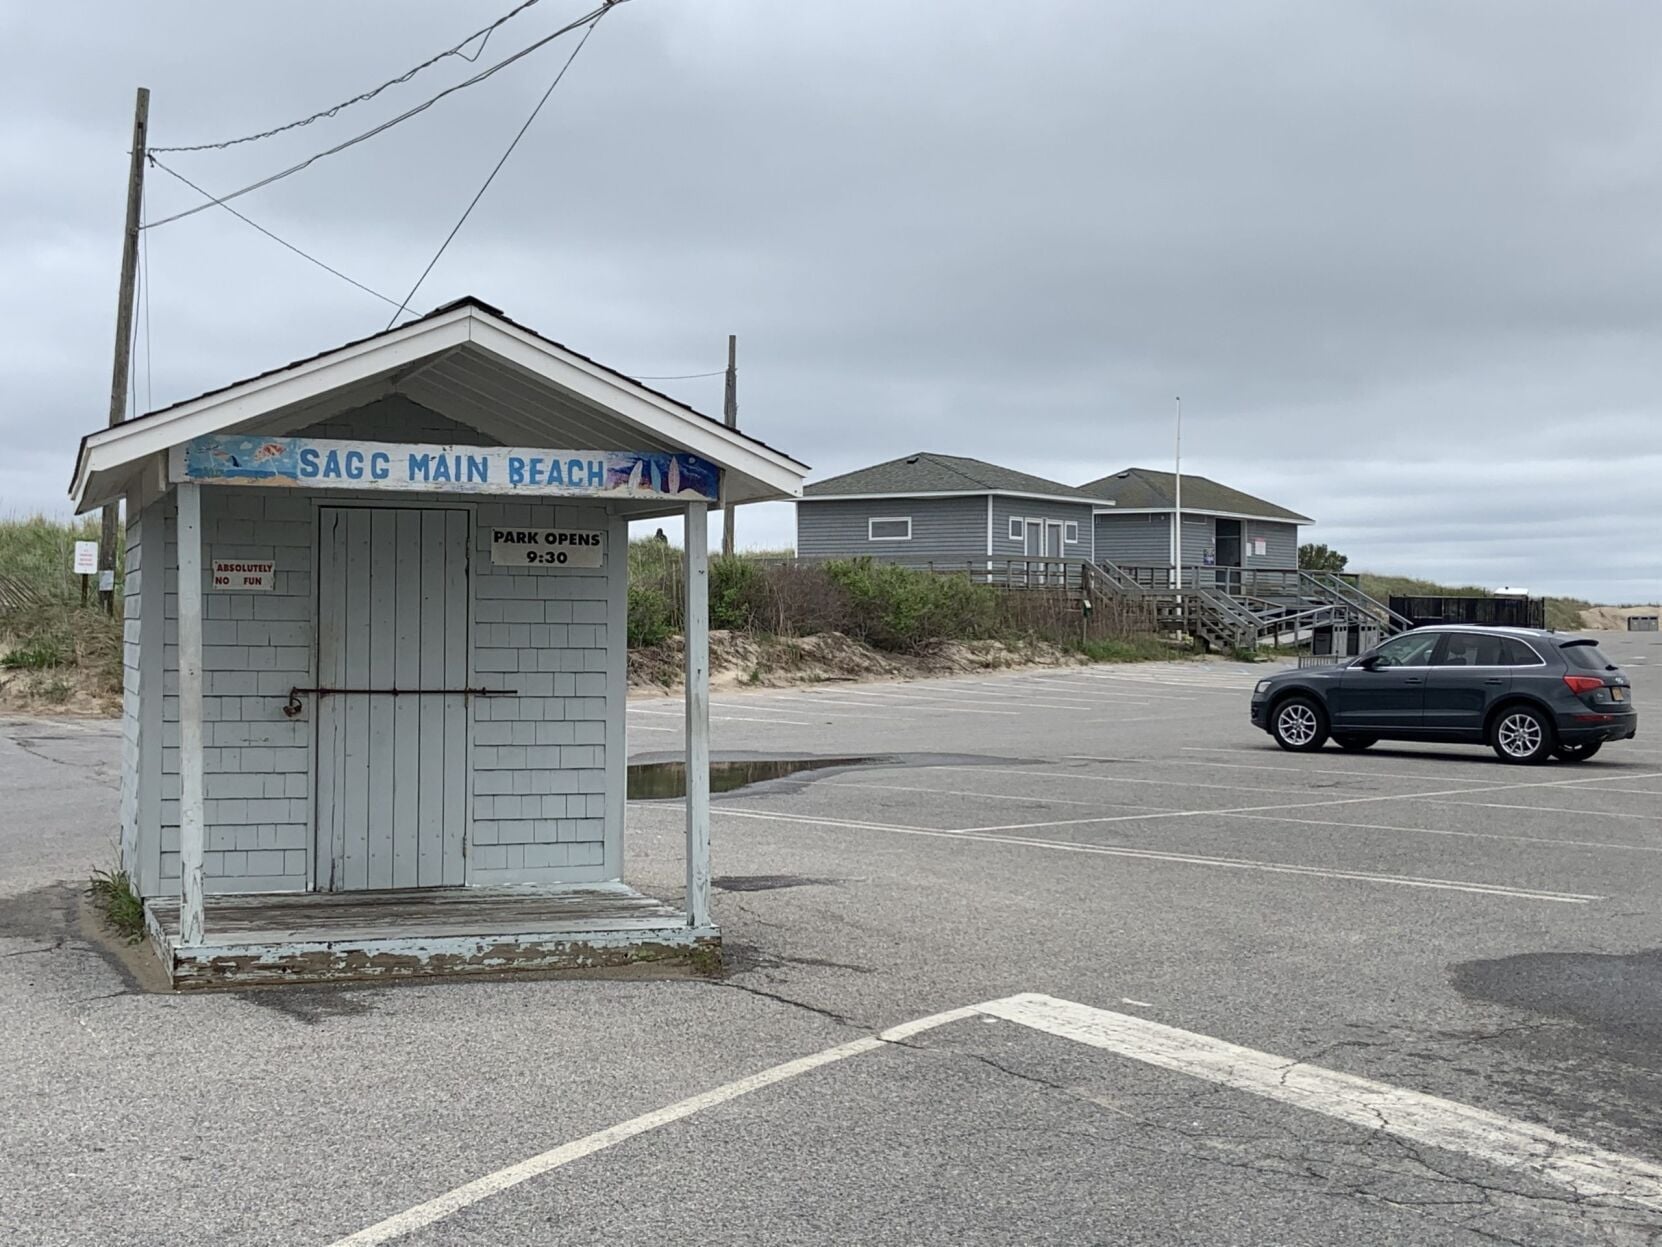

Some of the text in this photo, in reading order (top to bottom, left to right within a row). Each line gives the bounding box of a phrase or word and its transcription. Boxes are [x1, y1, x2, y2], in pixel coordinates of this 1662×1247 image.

[300, 448, 604, 487] SAGG MAIN BEACH
[494, 531, 601, 546] PARK OPENS
[526, 550, 568, 564] 9:30
[216, 563, 273, 573] ABSOLUTELY
[215, 576, 262, 585] NO FUN
